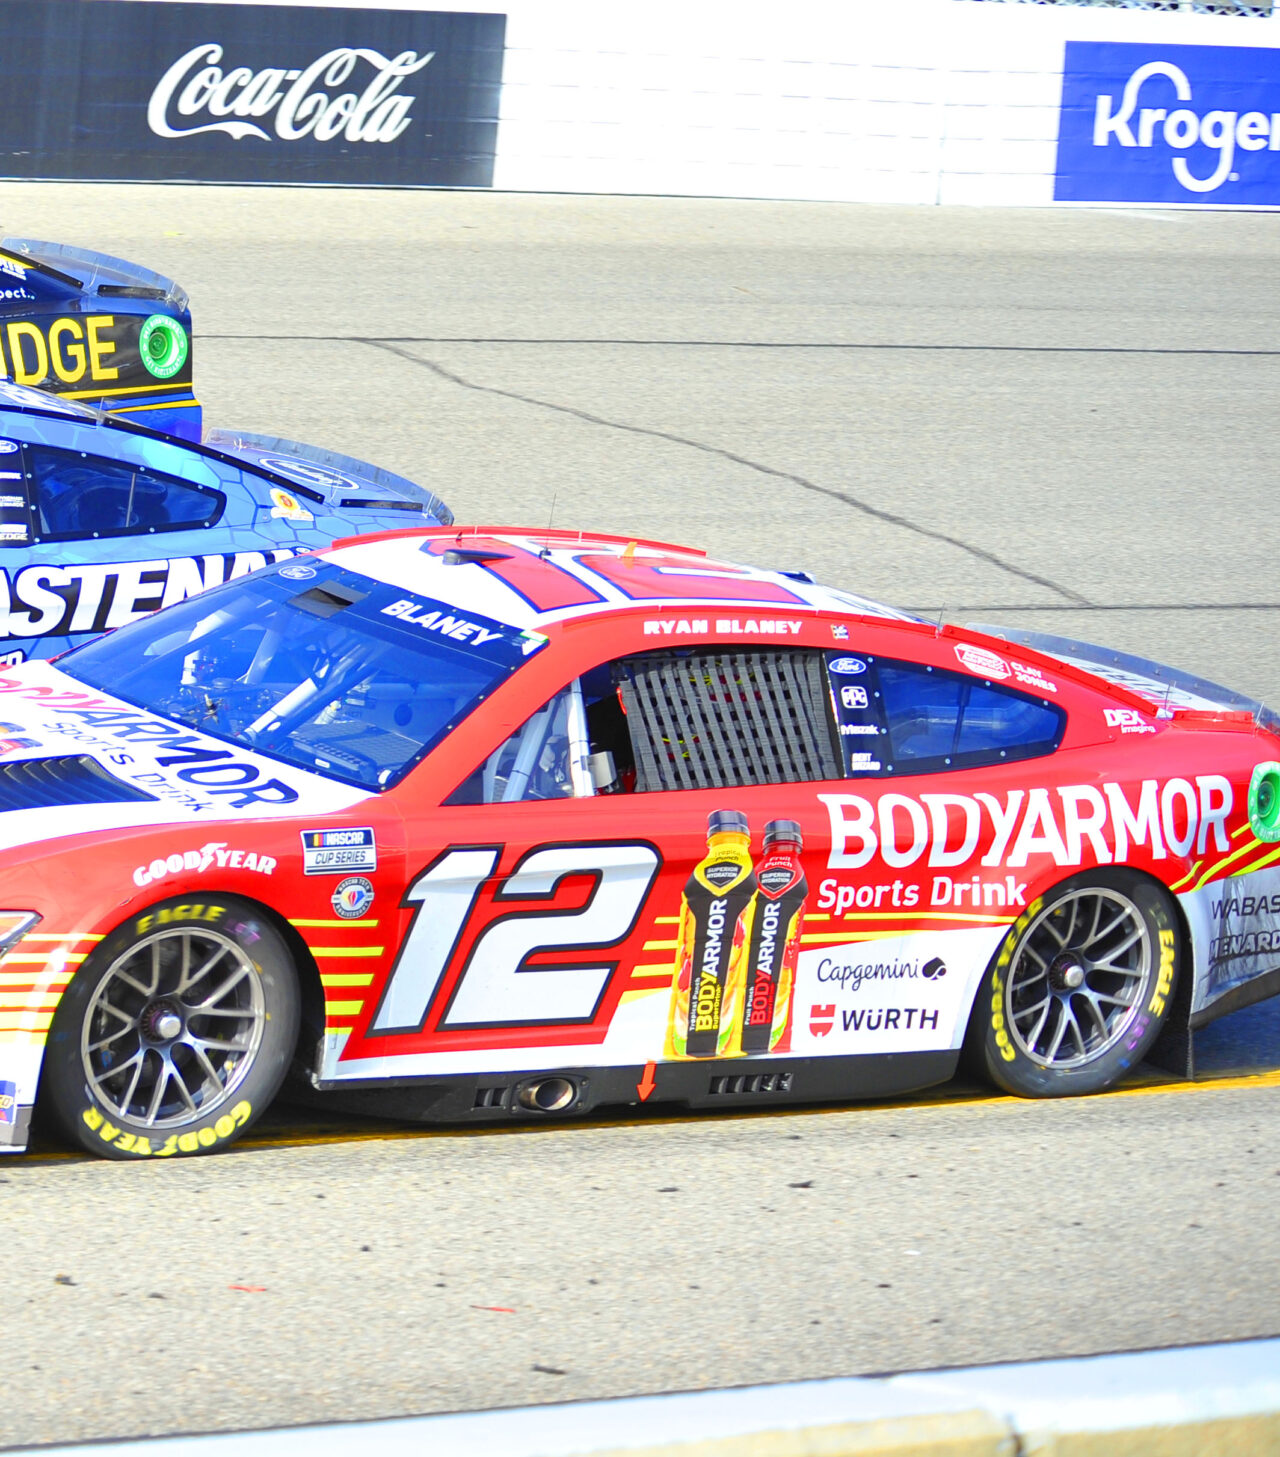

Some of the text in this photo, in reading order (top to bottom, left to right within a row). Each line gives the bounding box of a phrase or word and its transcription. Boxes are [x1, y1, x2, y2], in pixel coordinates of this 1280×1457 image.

[147, 43, 436, 142] Coca-Cola
[380, 599, 503, 647] BLANEY
[643, 619, 803, 636] RYAN BLANEY
[1011, 662, 1042, 678] CLAY
[1015, 672, 1058, 693] JONES
[1103, 708, 1146, 728] DEX
[42, 721, 216, 813] Sports Drink
[326, 832, 364, 846] NASCAR
[817, 774, 1234, 871] BODYARMOR
[132, 842, 278, 887] GOODYEAR
[315, 850, 367, 865] CUP SERIES
[817, 876, 1027, 915] Sports Drink
[136, 904, 227, 936] EAGLE
[365, 838, 665, 1038] 12
[695, 899, 728, 1032] BODYARMOR
[749, 902, 781, 1026] BODYARMOR
[817, 958, 919, 991] Capgemini
[1148, 929, 1175, 1018] EAGLE
[689, 977, 701, 1032] Tropical Punch
[747, 986, 755, 1005] Punch
[82, 1100, 252, 1157] GOODYEAR
